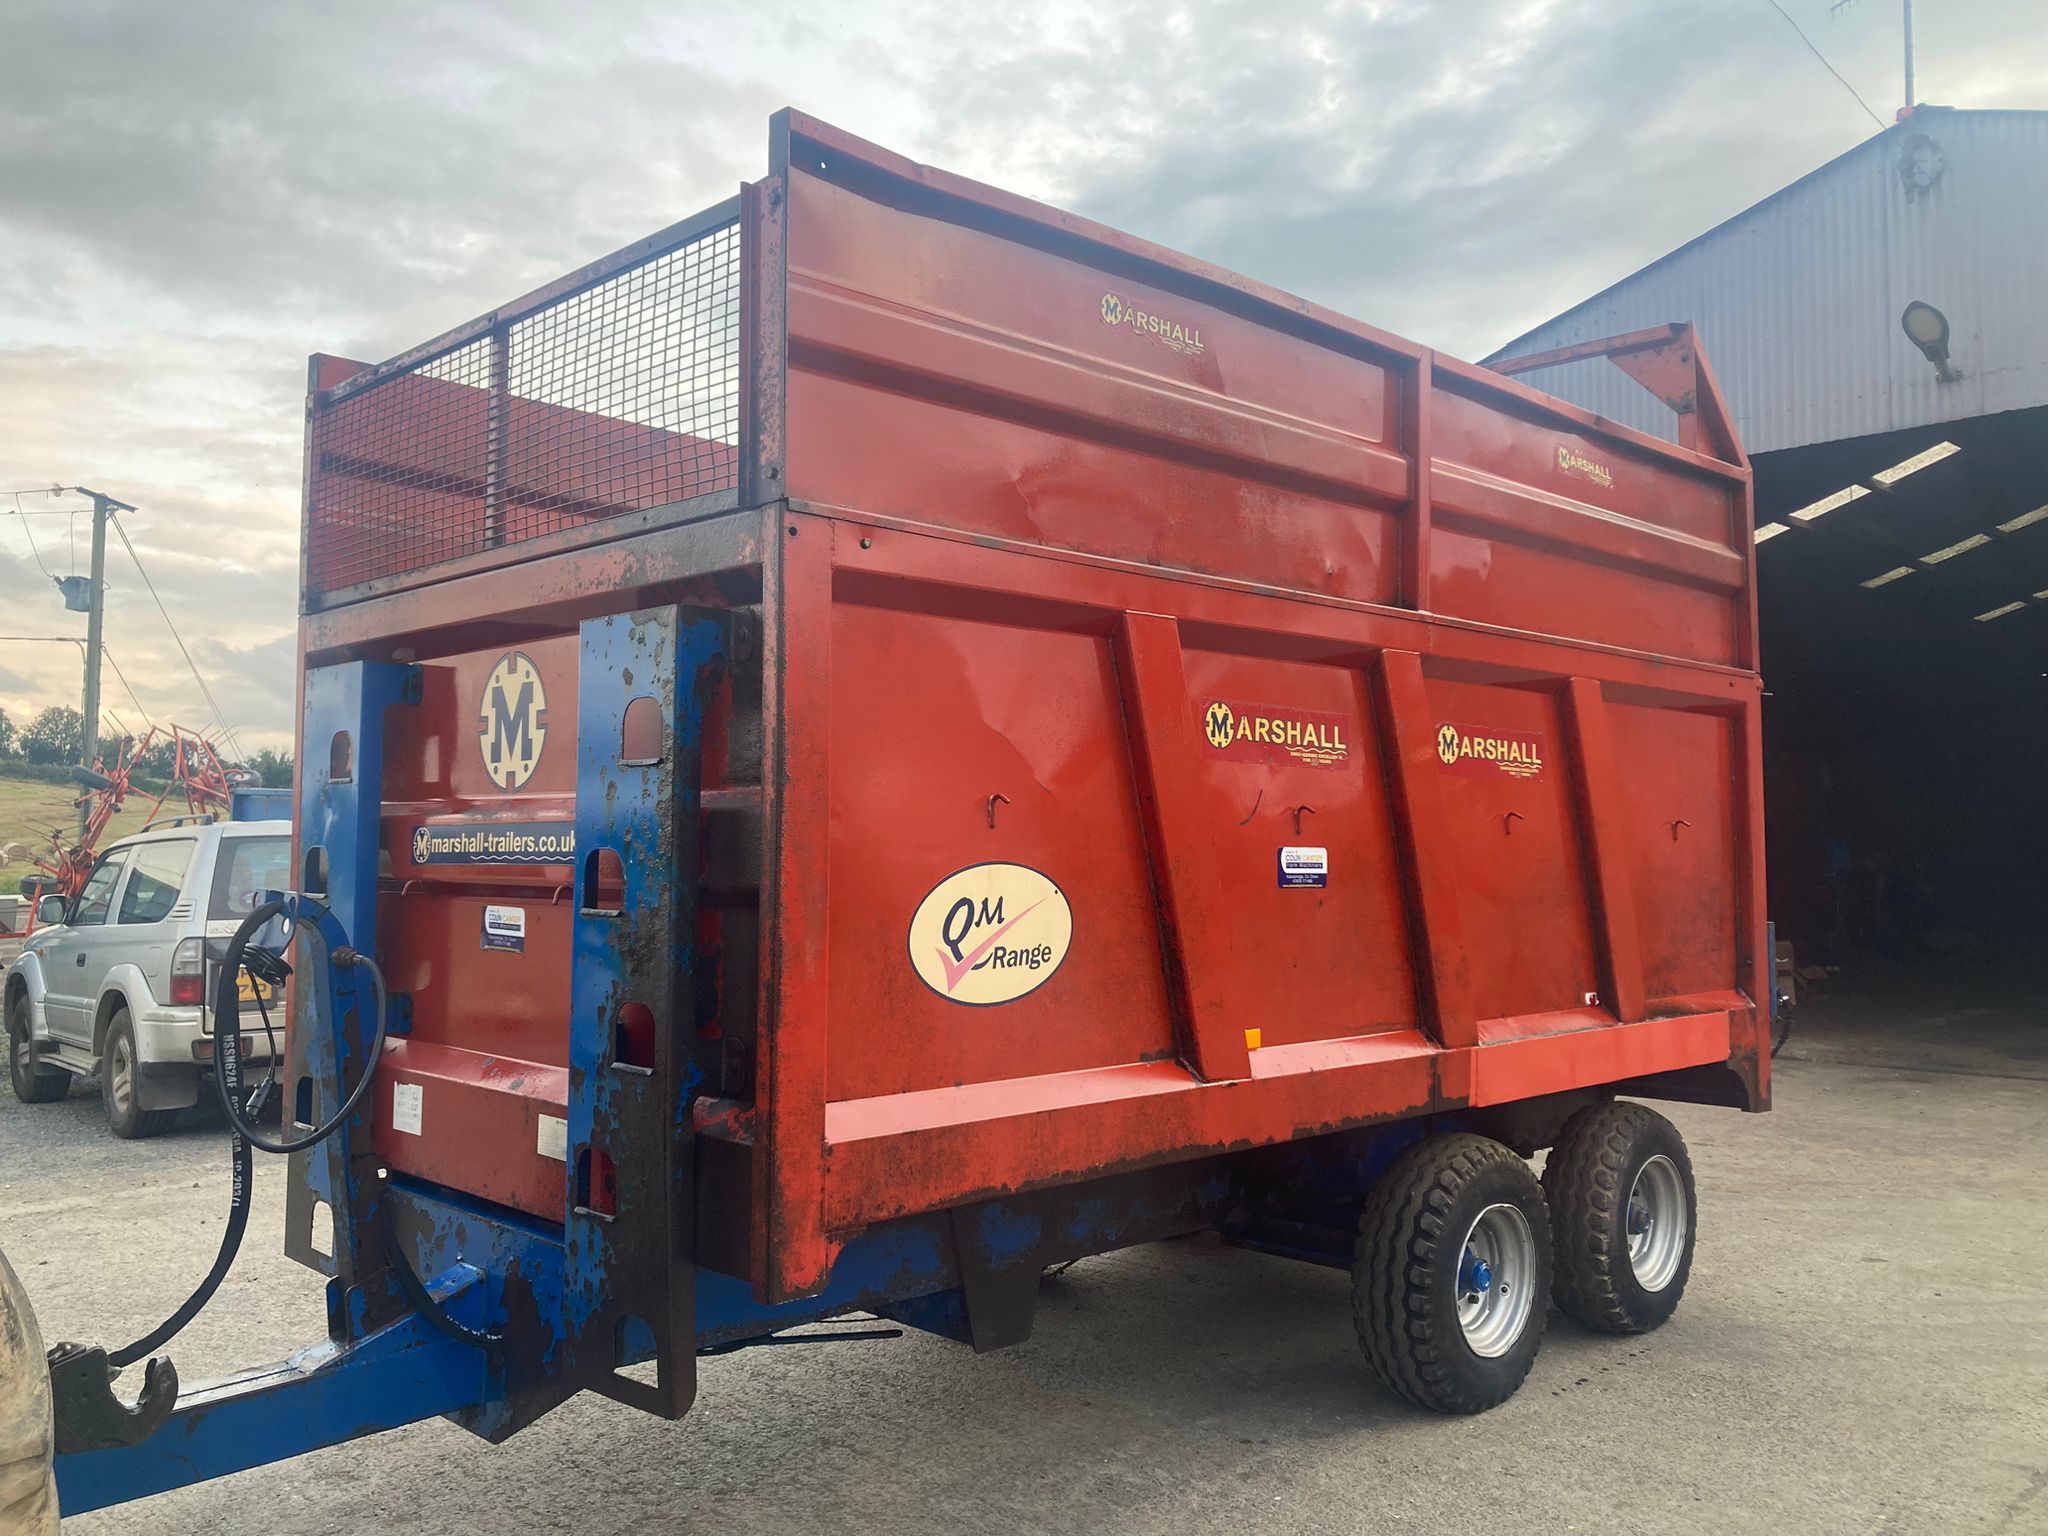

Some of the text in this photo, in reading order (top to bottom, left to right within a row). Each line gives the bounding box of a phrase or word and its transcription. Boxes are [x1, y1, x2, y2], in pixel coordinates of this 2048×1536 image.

[1102, 295, 1204, 348] MARSHALL
[1559, 448, 1612, 480] MARSHALL
[1206, 704, 1347, 749] MARSHALL
[1439, 727, 1542, 764] MARSHALL
[431, 830, 576, 853] marshall-trailers.co.uk
[942, 896, 1005, 963] QM
[992, 944, 1052, 970] Range
